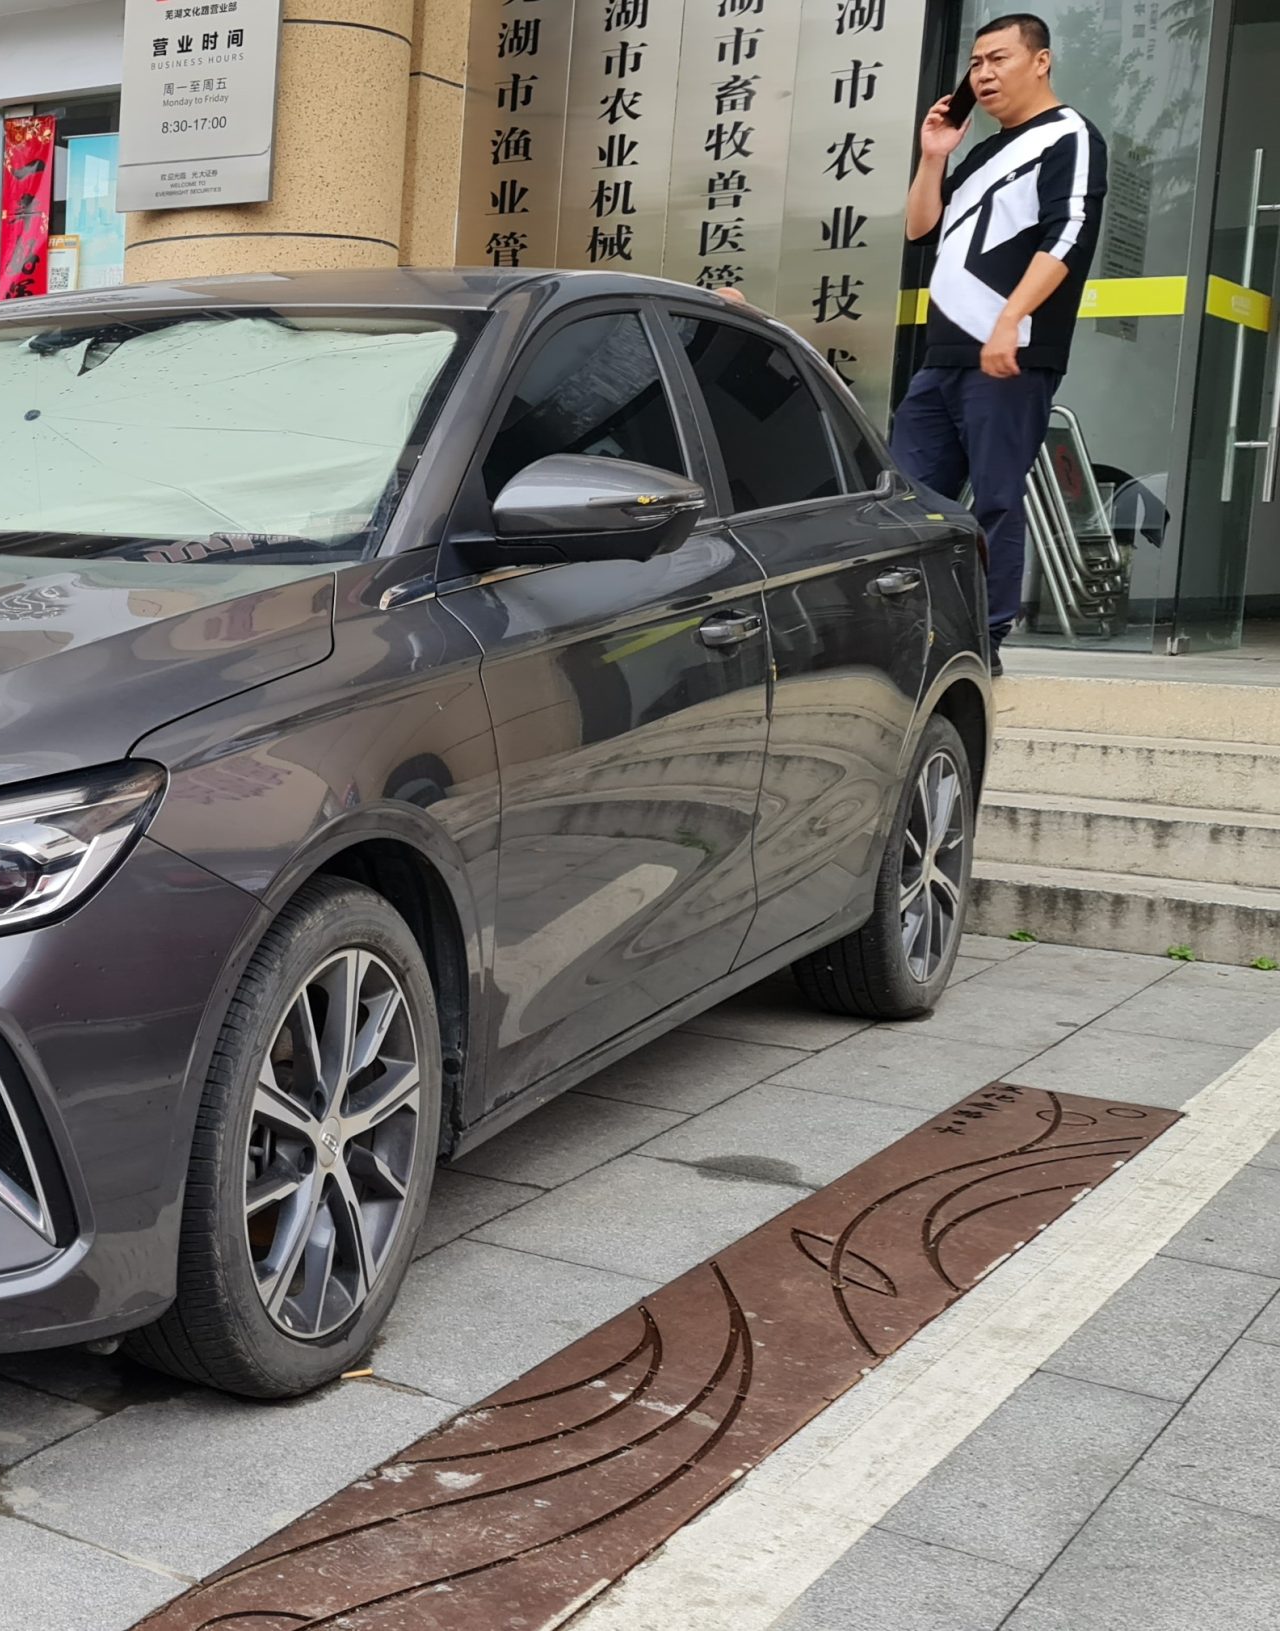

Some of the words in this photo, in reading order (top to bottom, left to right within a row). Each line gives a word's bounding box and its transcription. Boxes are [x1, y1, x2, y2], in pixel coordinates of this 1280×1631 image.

[165, 1, 237, 20] 芜湖文化路营业部
[152, 29, 244, 57] 营业时间
[150, 57, 203, 70] BUSINESS
[208, 53, 245, 64] HOURS
[163, 77, 228, 96] 周一至周五
[162, 97, 193, 107] Monday
[195, 97, 203, 105] to
[204, 93, 229, 104] Friday
[161, 116, 227, 134] 8:30-17:00
[485, 0, 541, 267] 湖市渔业管
